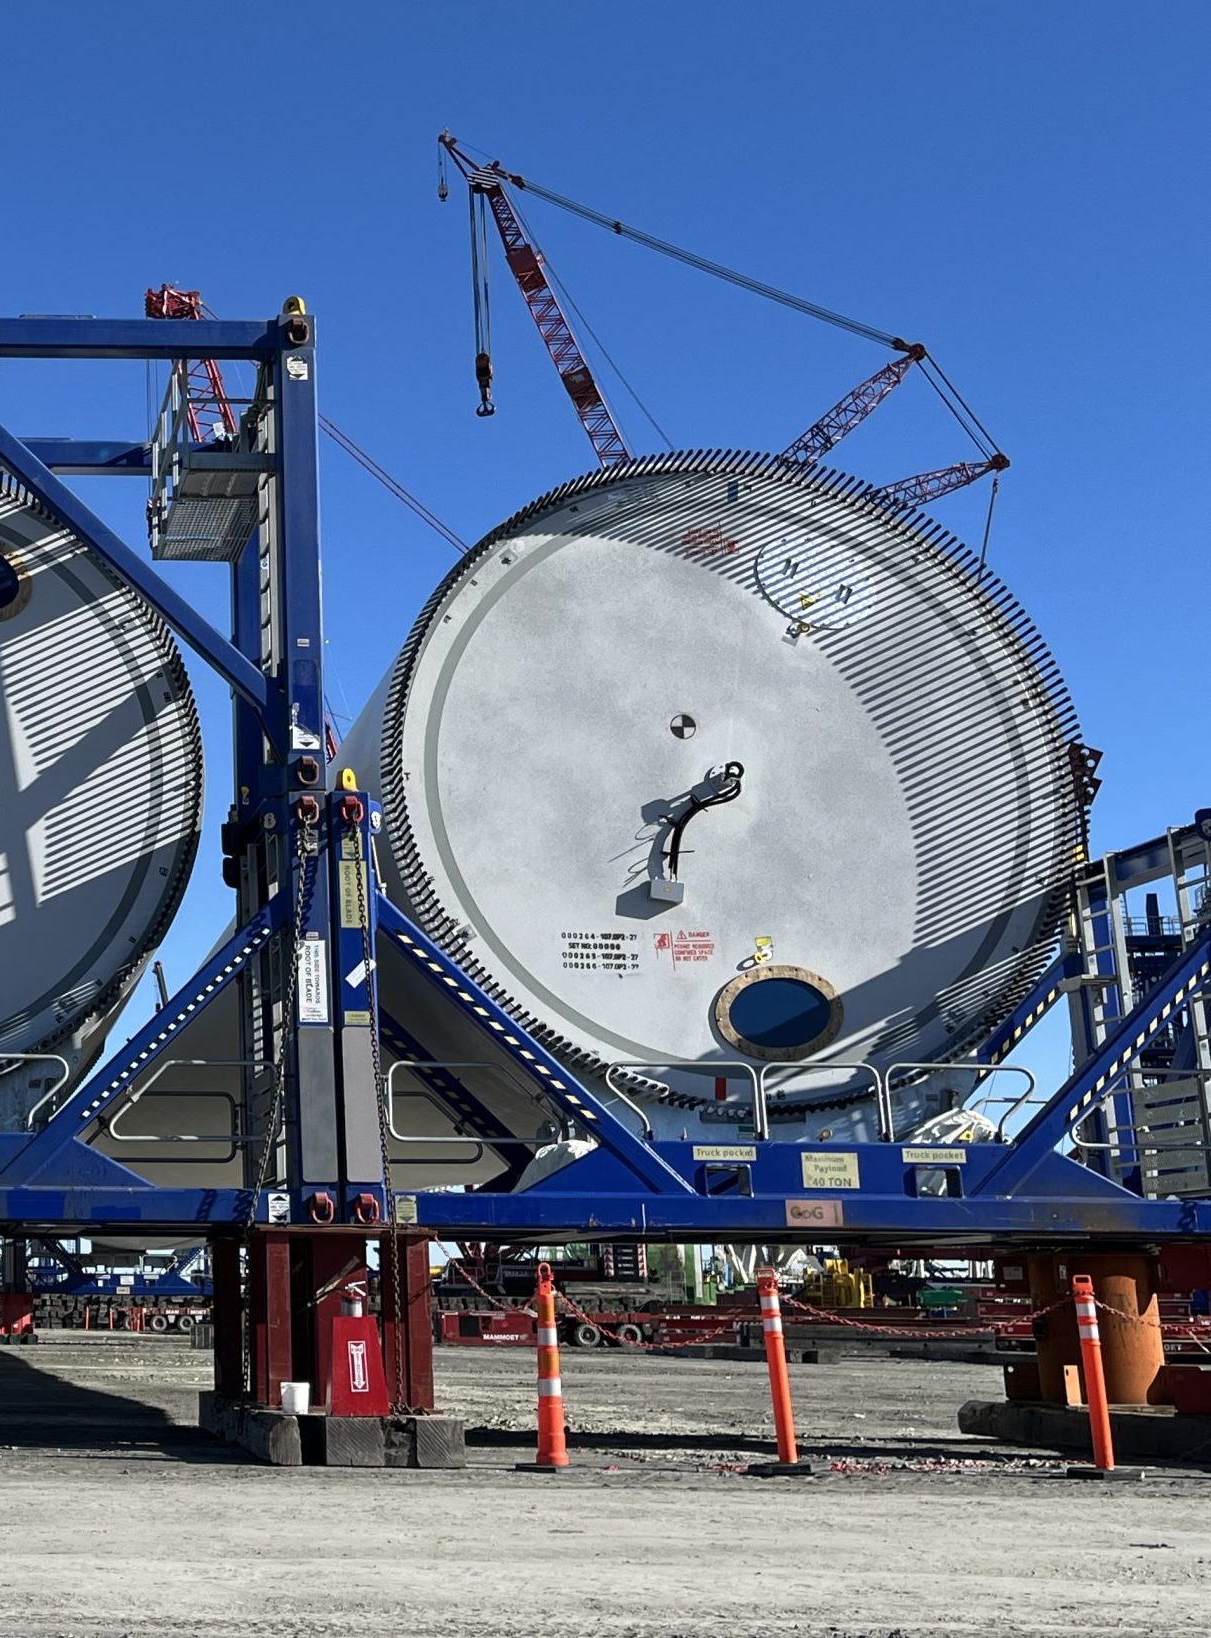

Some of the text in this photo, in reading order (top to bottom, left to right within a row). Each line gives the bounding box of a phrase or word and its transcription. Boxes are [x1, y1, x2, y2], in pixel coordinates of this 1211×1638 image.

[305, 968, 312, 977] OF
[305, 978, 313, 1004] BLADE
[696, 1149, 721, 1157] Truck
[906, 1151, 963, 1161] Truck pocket
[805, 1155, 844, 1163] Maximum
[814, 1165, 847, 1173] Payload
[813, 1177, 852, 1187] 40 TON
[790, 1206, 824, 1220] CoG
